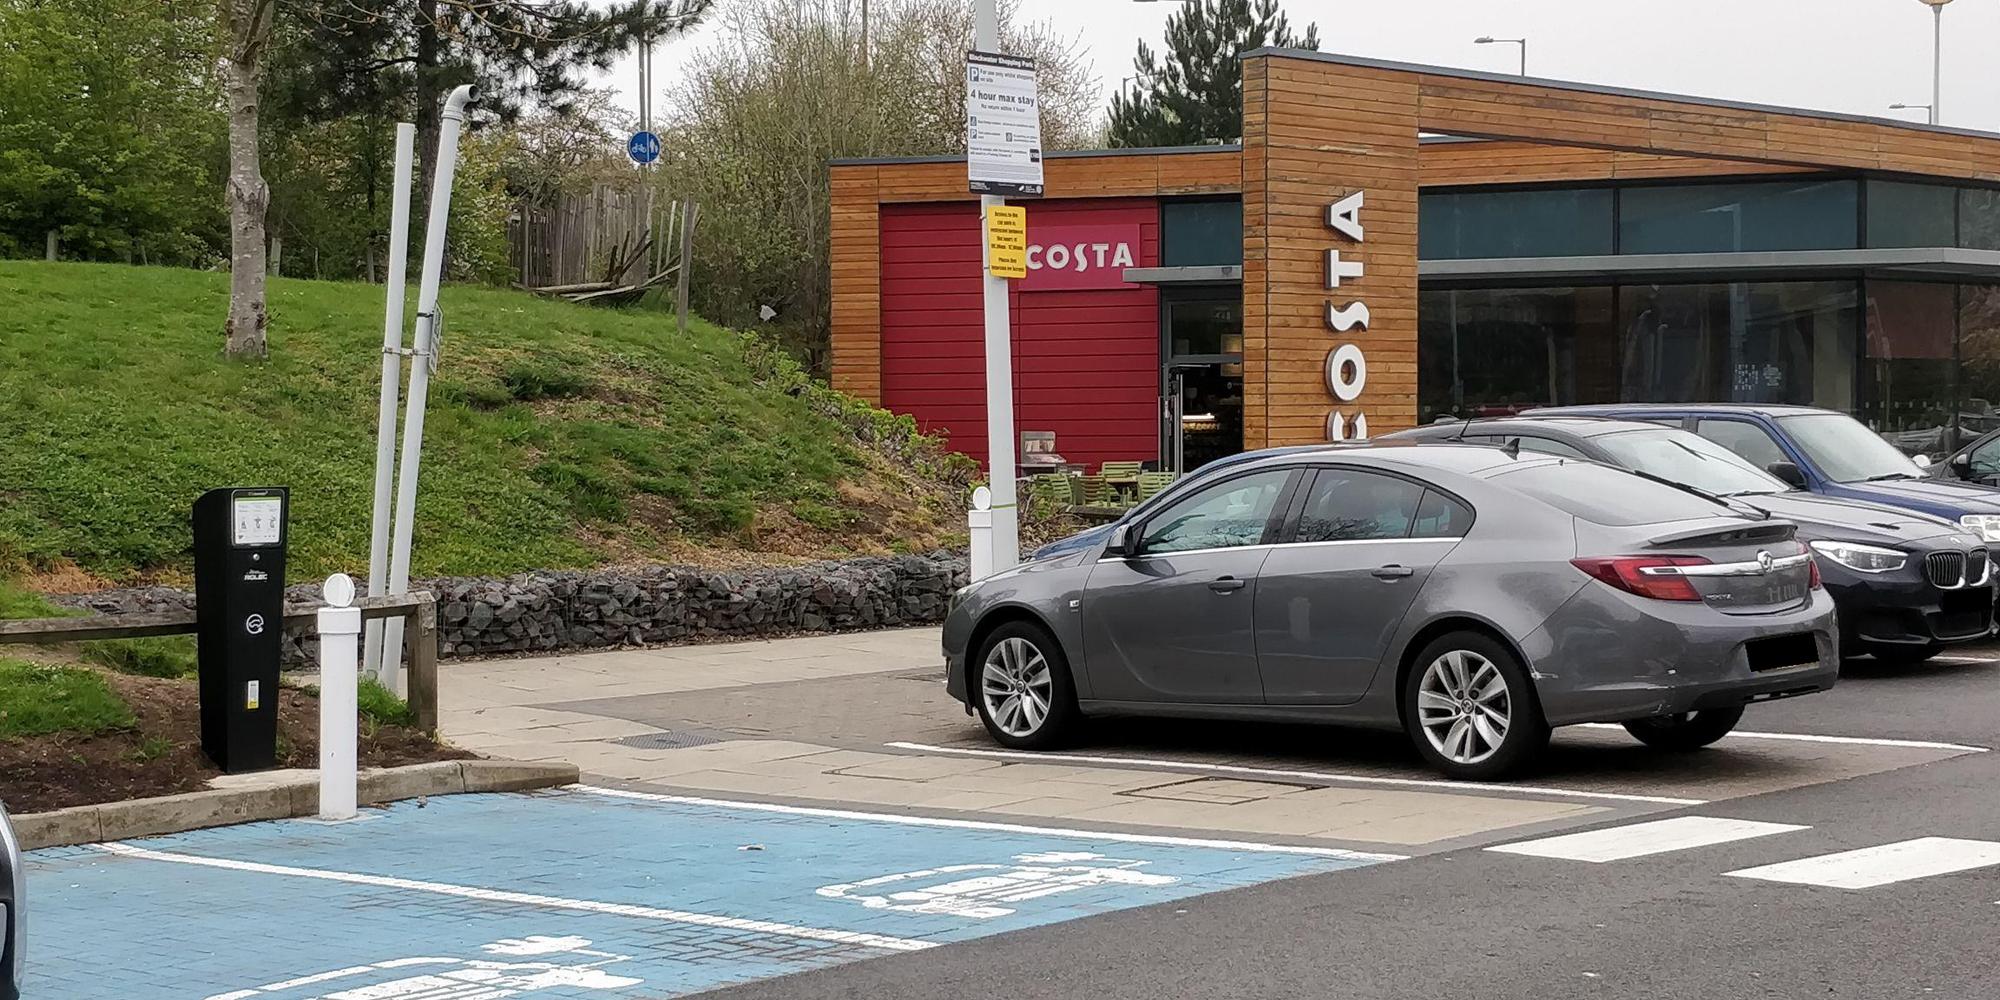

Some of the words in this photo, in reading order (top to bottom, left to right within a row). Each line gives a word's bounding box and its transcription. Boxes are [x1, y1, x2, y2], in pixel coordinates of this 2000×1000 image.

[971, 89, 976, 98] 4
[978, 90, 997, 100] hour
[998, 94, 1016, 103] max
[1017, 96, 1035, 107] stay
[1025, 242, 1134, 272] COSTA
[1325, 190, 1370, 442] COSTA
